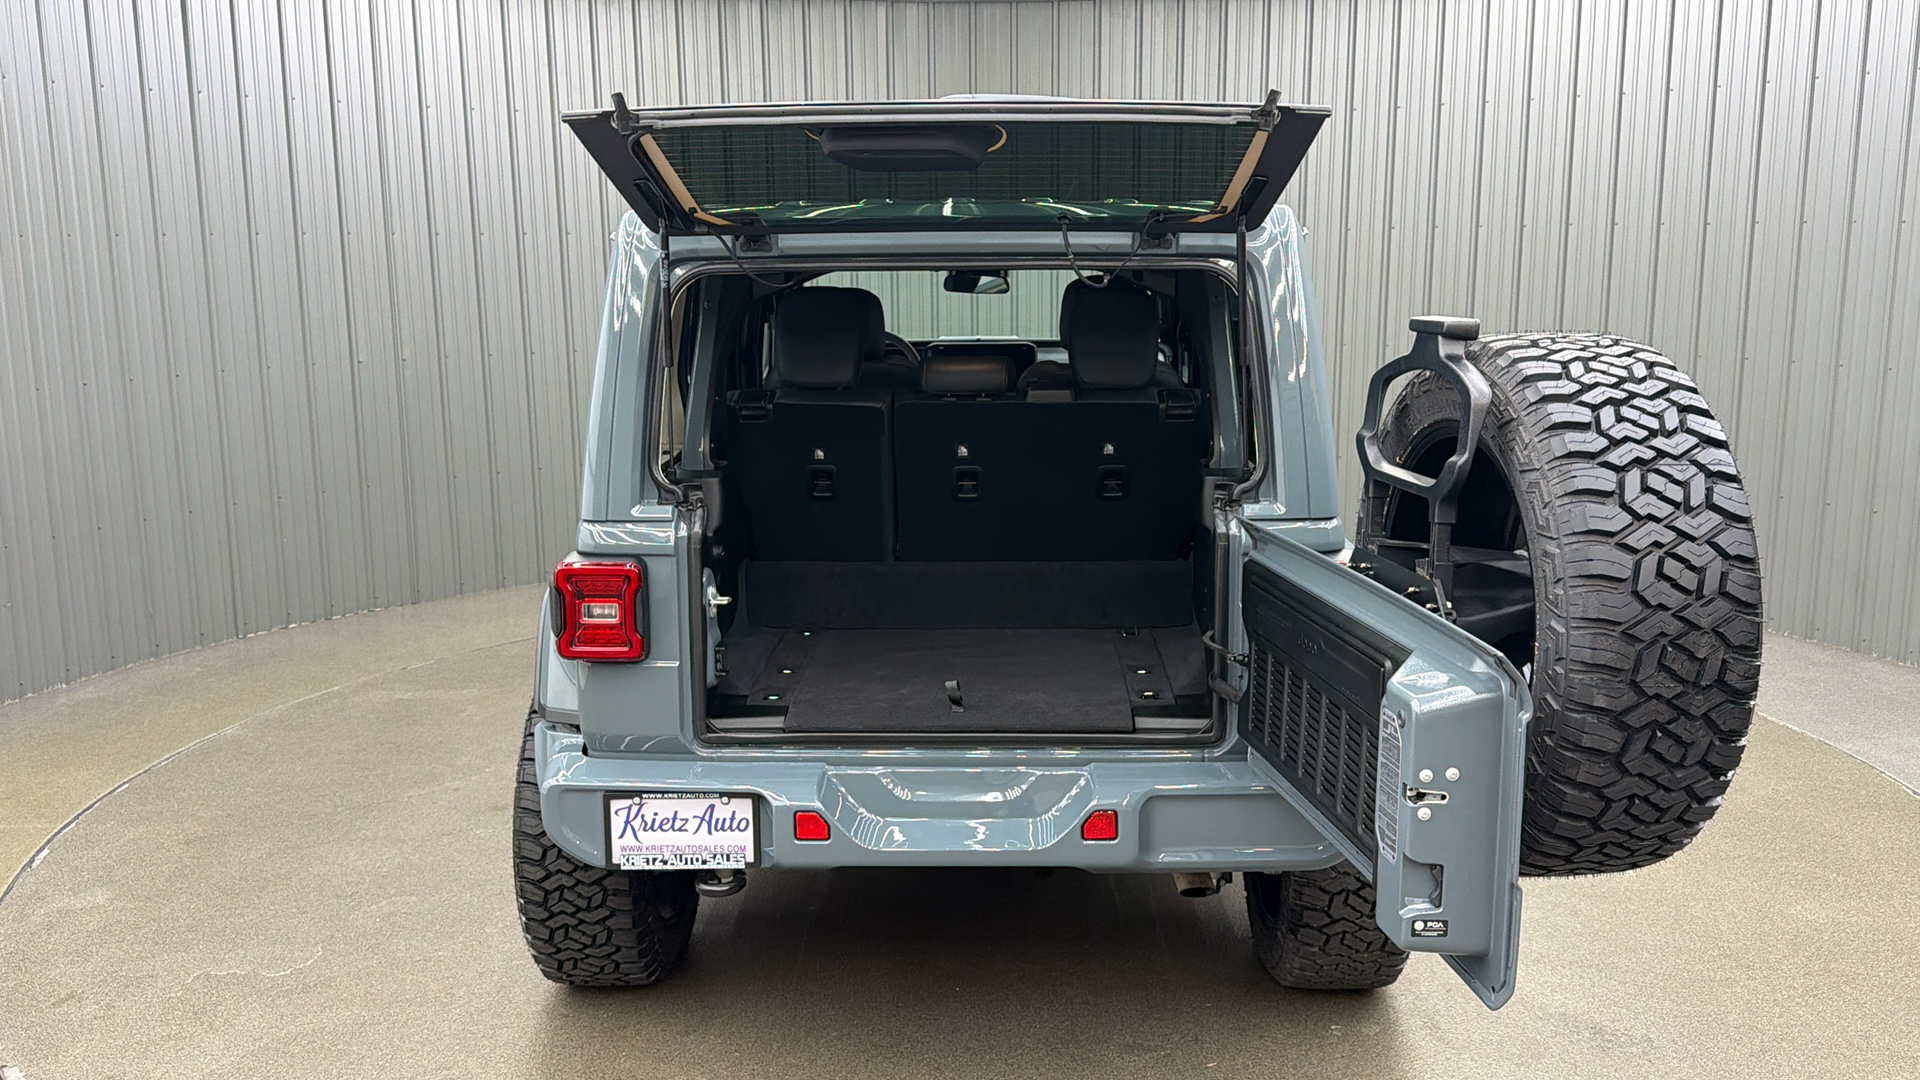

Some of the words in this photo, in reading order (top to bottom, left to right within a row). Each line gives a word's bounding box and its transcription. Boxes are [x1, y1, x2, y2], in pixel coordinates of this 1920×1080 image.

[614, 802, 690, 844] Krietz
[692, 803, 750, 836] Auto
[620, 844, 747, 853] WWW.KRIETZAUTOSALES.COM
[620, 854, 664, 866] KRIETZ
[667, 854, 703, 866] AUTO
[706, 853, 746, 866] SALES
